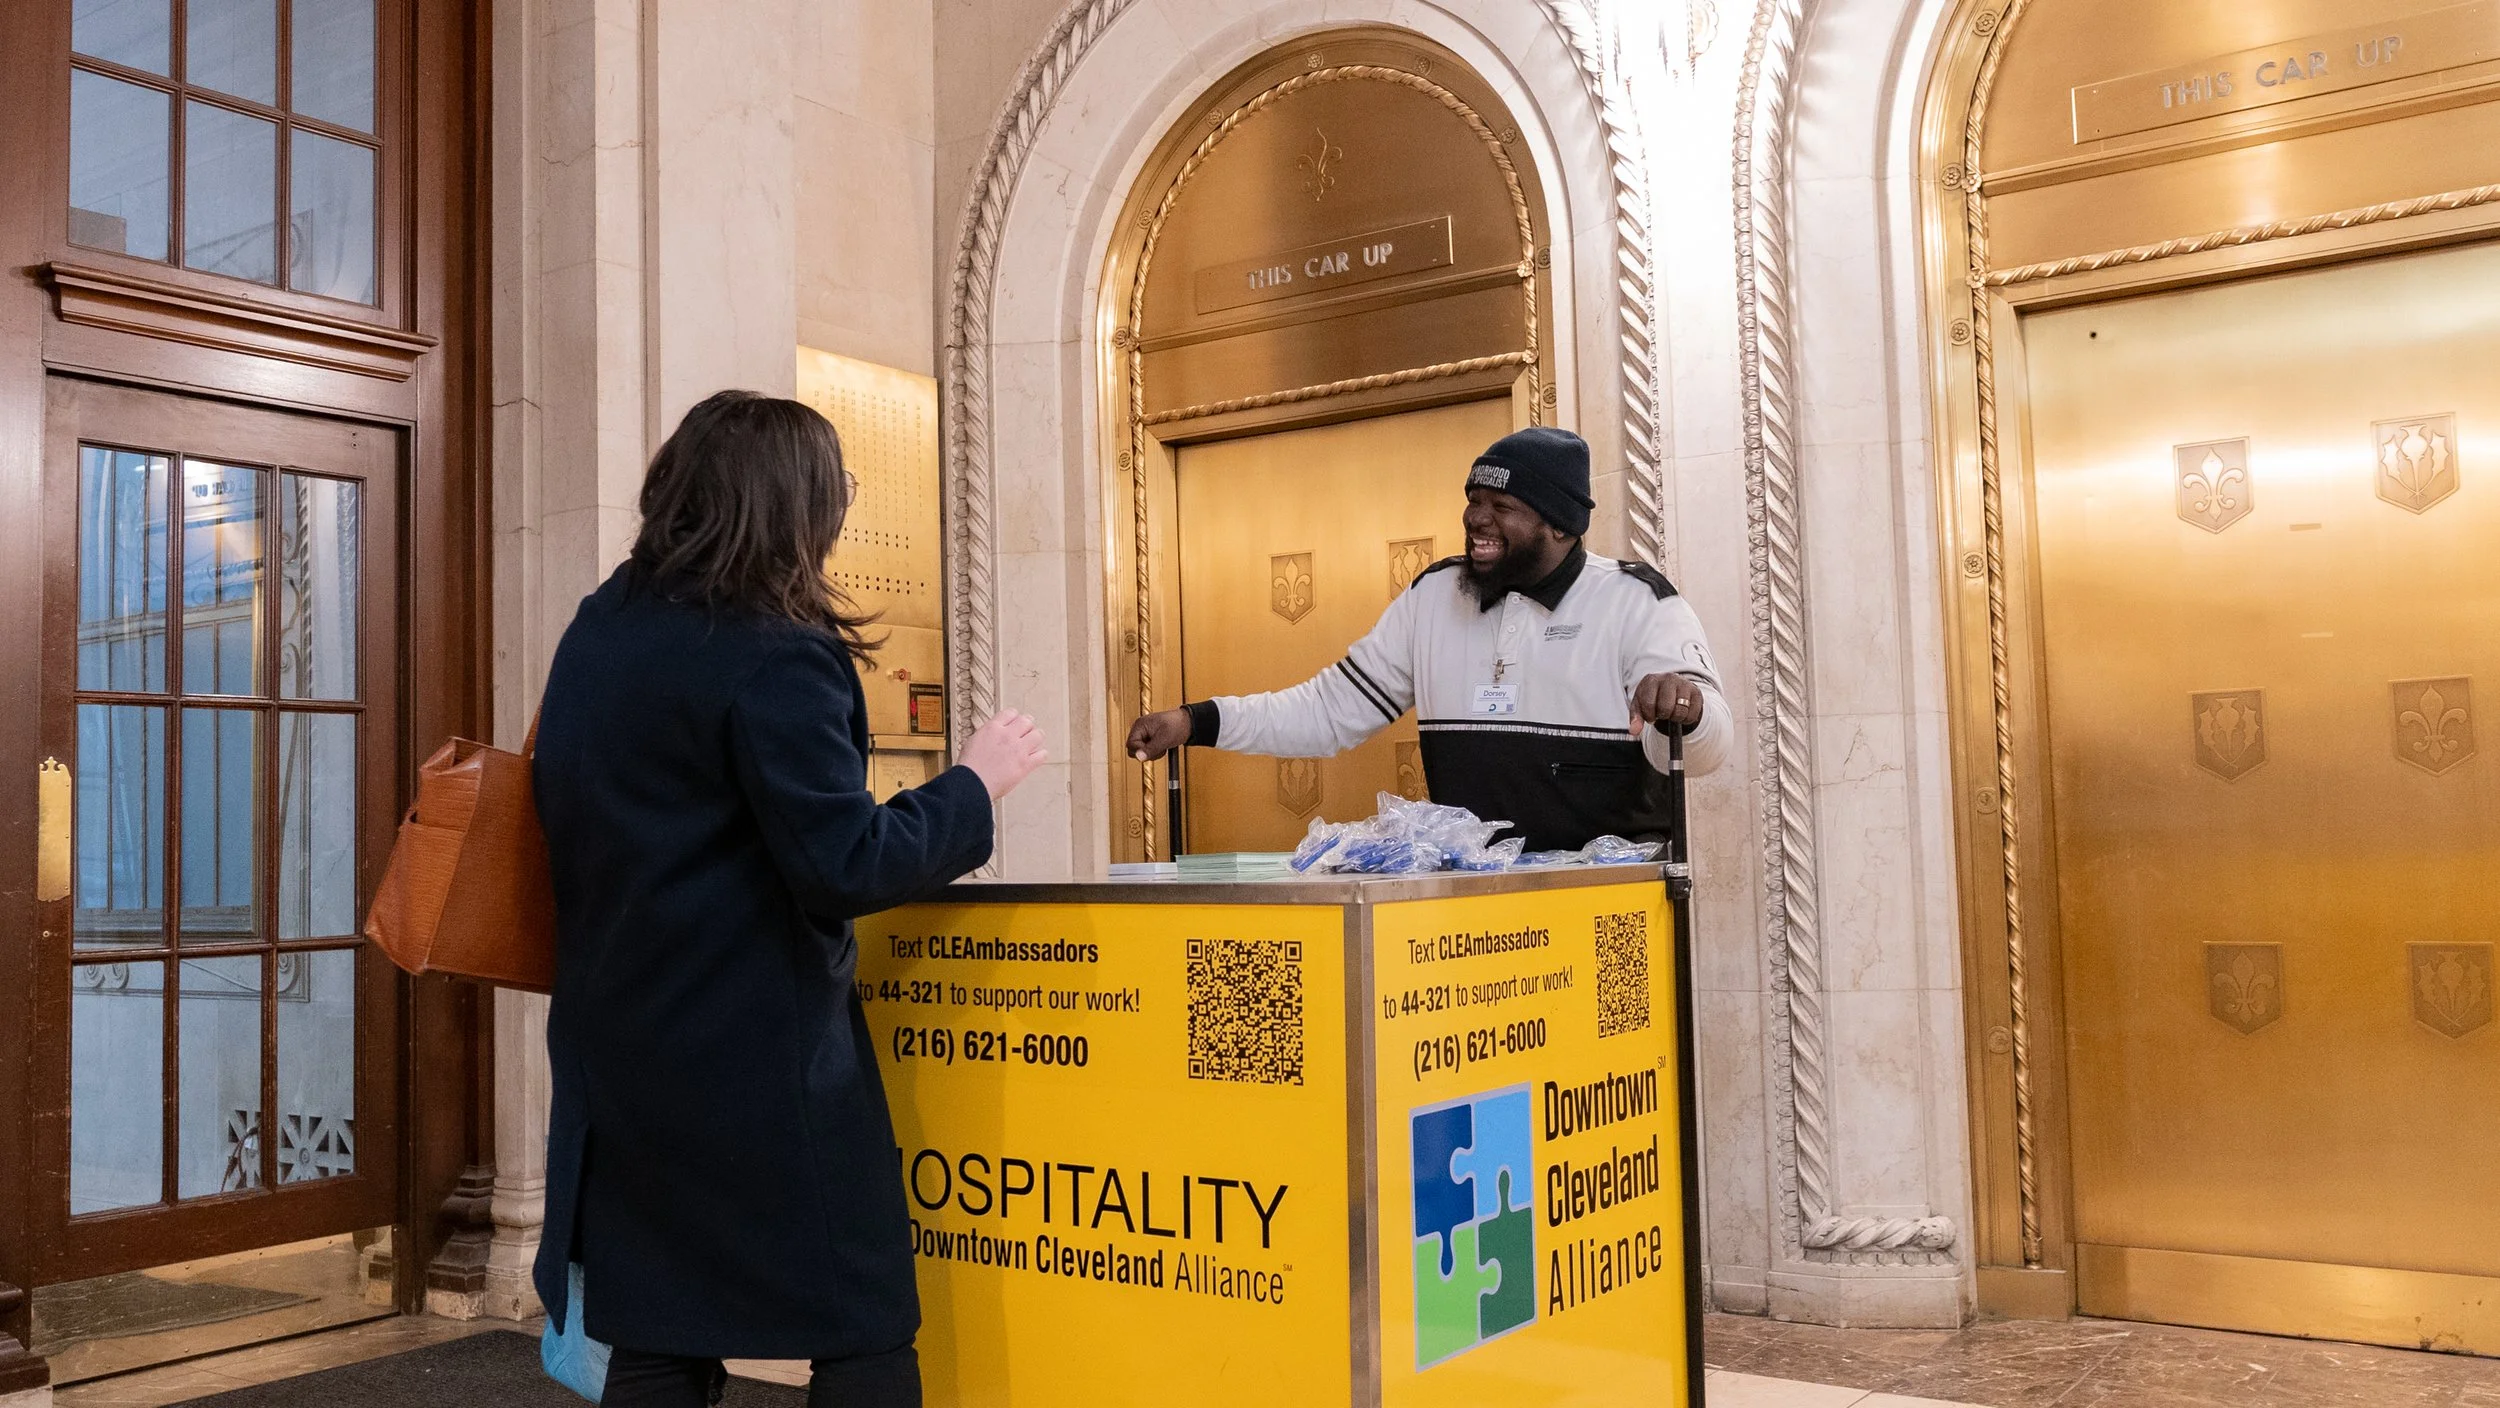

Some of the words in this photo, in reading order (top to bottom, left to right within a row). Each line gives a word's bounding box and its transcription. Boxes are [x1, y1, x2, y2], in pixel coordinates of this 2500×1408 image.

[2159, 72, 2232, 108] THIS
[2255, 52, 2328, 87] CAR
[2356, 36, 2402, 67] UP
[1248, 264, 1292, 290] THIS
[1304, 252, 1349, 278] CAR
[1363, 243, 1393, 267] UP
[1483, 690, 1507, 698] Dorsey
[888, 935, 923, 959] Text
[928, 936, 1099, 963] CLEAmbassadors
[1408, 937, 1435, 965] Text
[1439, 926, 1549, 960] CLEAmbassadors
[858, 980, 874, 1001] to
[879, 980, 943, 1004] 44-321
[950, 983, 967, 1005] to
[973, 985, 1043, 1013] support
[1048, 989, 1079, 1010] our
[1085, 988, 1140, 1013] work!
[1383, 994, 1397, 1019] to
[1401, 985, 1451, 1016] 44-321
[1456, 985, 1468, 1007] to
[1472, 979, 1517, 1008] support
[1521, 976, 1539, 997] our
[1542, 965, 1573, 992] work!
[892, 1029, 955, 1066] (216)
[963, 1031, 1089, 1067] 621-6000
[1413, 1034, 1461, 1081] (216)
[1467, 1018, 1547, 1063] 621-6000
[1544, 1067, 1658, 1142] Downtown
[897, 1147, 1288, 1249] OSPITALITY
[1547, 1134, 1660, 1228] Cleveland
[1036, 1235, 1164, 1288] Cleveland
[1174, 1252, 1285, 1305] Alliance
[1548, 1225, 1662, 1317] Alliance
